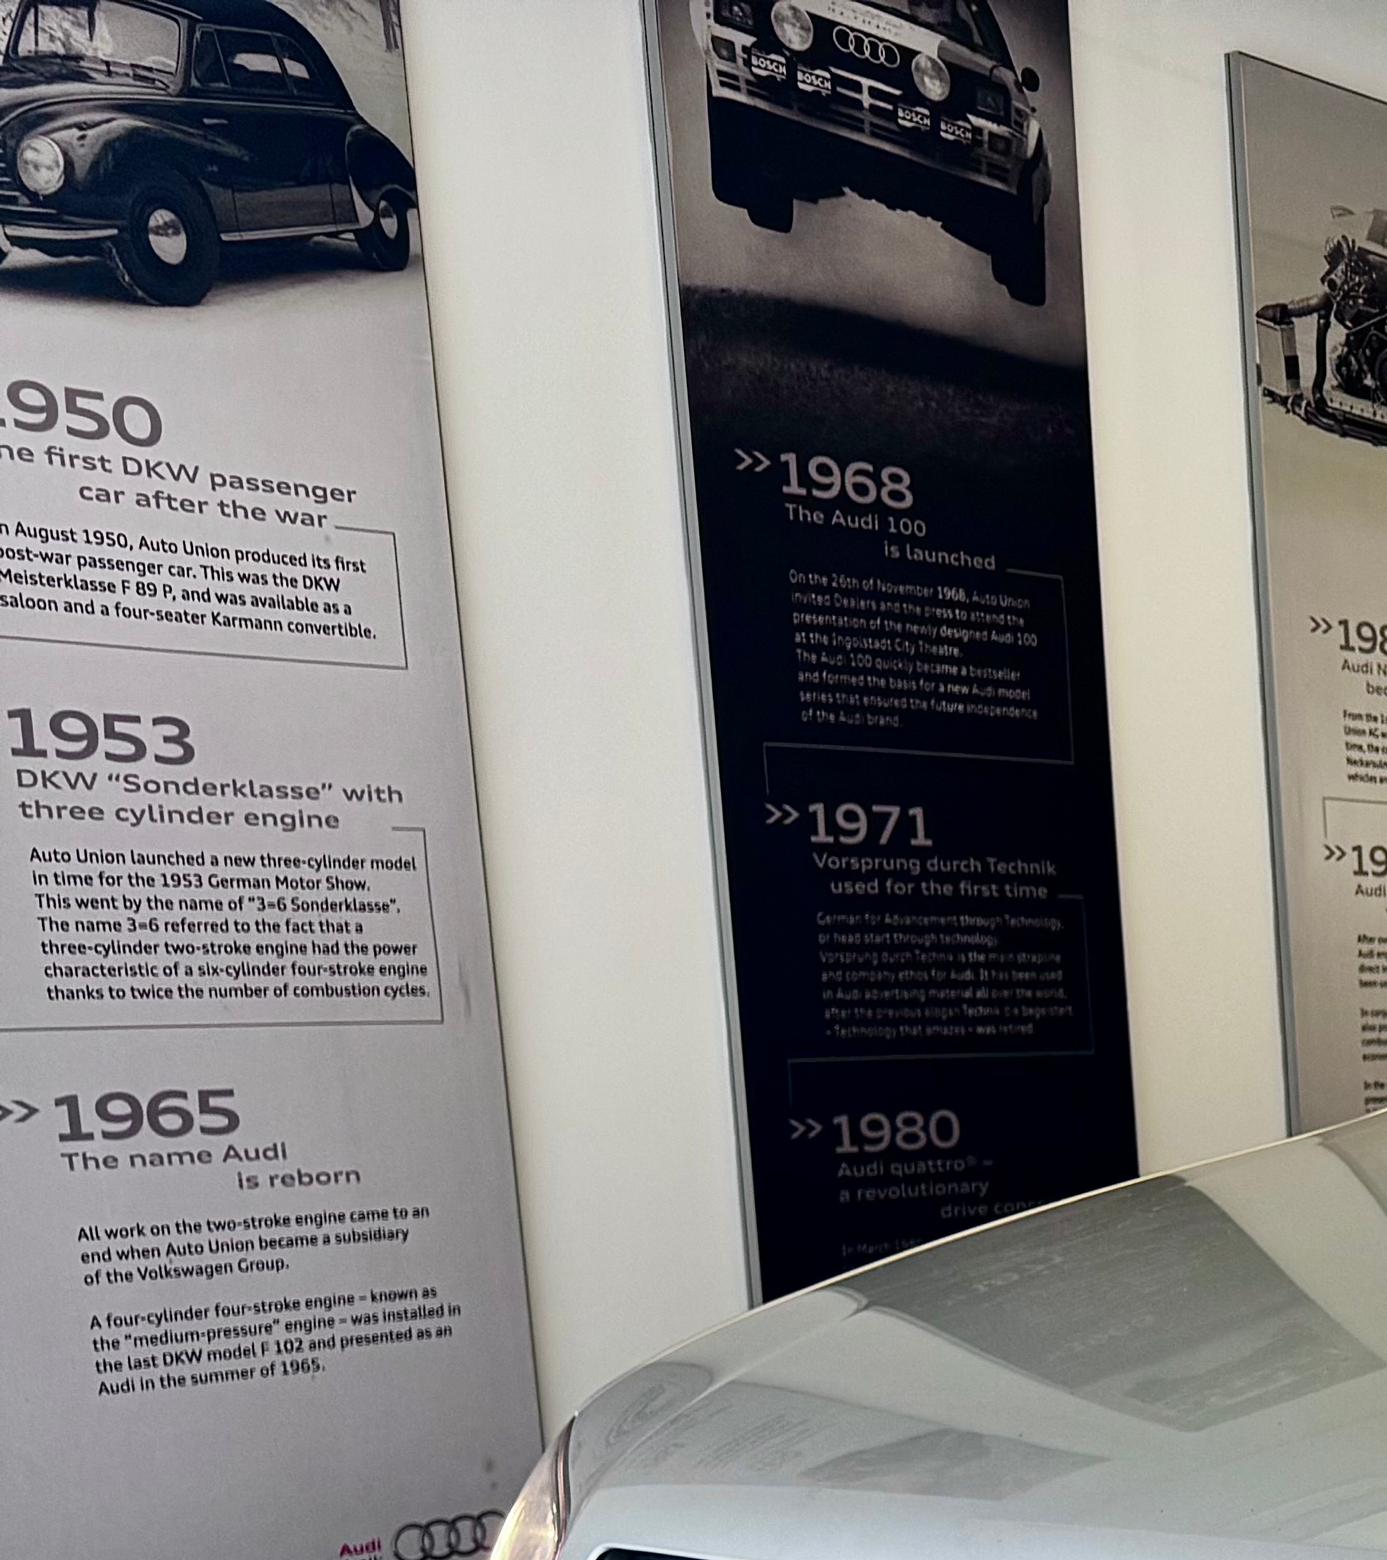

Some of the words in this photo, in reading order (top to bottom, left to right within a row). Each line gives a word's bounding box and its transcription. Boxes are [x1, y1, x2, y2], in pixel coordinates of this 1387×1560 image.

[751, 55, 787, 77] BOSCH
[797, 70, 833, 91] BOSCH
[897, 107, 932, 127] BOSCH
[940, 120, 973, 141] BOSCH
[0, 379, 164, 449] 950
[43, 445, 112, 474] first
[121, 455, 199, 484] DKW
[209, 472, 357, 504] passenger
[779, 451, 915, 511] 1968
[78, 485, 125, 504] car
[135, 489, 209, 514] after
[216, 499, 266, 522] the
[274, 508, 328, 528] war
[784, 502, 824, 524] The
[831, 509, 879, 531] Audi
[888, 516, 926, 537] 100
[14, 520, 78, 544] August
[82, 528, 133, 552] 1950,
[138, 535, 178, 554] Auto
[182, 539, 230, 560] Union
[234, 547, 308, 567] produced
[311, 553, 331, 570] its
[334, 555, 367, 573] first
[884, 540, 900, 558] is
[905, 543, 996, 570] launched
[76, 555, 164, 577] passenger
[167, 564, 197, 579] car.
[199, 564, 234, 583] This
[237, 571, 268, 586] was
[271, 571, 298, 589] the
[302, 574, 340, 592] DKW
[121, 579, 130, 595] F
[135, 580, 157, 597] 89
[162, 583, 176, 602] P,
[181, 587, 211, 603] and
[214, 592, 246, 606] was
[250, 593, 319, 613] available
[323, 601, 340, 614] as
[343, 603, 352, 615] a
[0, 591, 58, 612] saloon
[63, 598, 95, 615] and
[100, 604, 110, 616] a
[114, 601, 207, 625] four-seater
[211, 611, 283, 632] Karmann
[287, 621, 376, 639] convertible.
[1341, 658, 1373, 675] Audi
[7, 707, 197, 767] 1953
[16, 768, 98, 791] DKW
[342, 783, 403, 803] with
[18, 799, 104, 821] three
[114, 803, 235, 828] cylinder
[243, 809, 339, 832] engine
[808, 802, 934, 849] 1971
[29, 846, 71, 863] Auto
[75, 848, 126, 865] Union
[130, 849, 205, 867] launched
[210, 854, 219, 867] a
[223, 855, 256, 867] new
[259, 852, 365, 873] three-cylinder
[370, 855, 416, 871] model
[812, 851, 921, 875] Vorsprung
[926, 855, 982, 873] durch
[986, 856, 1056, 875] Technik
[829, 877, 879, 895] used
[885, 877, 915, 895] for
[920, 879, 953, 896] the
[959, 880, 999, 897] first
[1004, 882, 1048, 899] time
[1354, 883, 1387, 898] Audi
[53, 1088, 242, 1145] 1965
[832, 1109, 962, 1156] 1980
[60, 1151, 119, 1172] The
[129, 1149, 212, 1168] name
[222, 1141, 287, 1163] Audi
[237, 1171, 259, 1190] is
[268, 1167, 361, 1188] reborn
[77, 1225, 101, 1242] All
[104, 1222, 146, 1240] work
[149, 1223, 171, 1236] on
[174, 1218, 202, 1235] the
[206, 1212, 291, 1233] two-stroke
[294, 1210, 346, 1229] engine
[349, 1209, 389, 1223] came
[392, 1207, 408, 1220] to
[412, 1206, 430, 1218] an
[83, 1268, 101, 1286] of
[105, 1267, 133, 1284] the
[136, 1262, 233, 1281] Volkswagen
[237, 1257, 289, 1273] Group.
[339, 1538, 381, 1558] Audi
